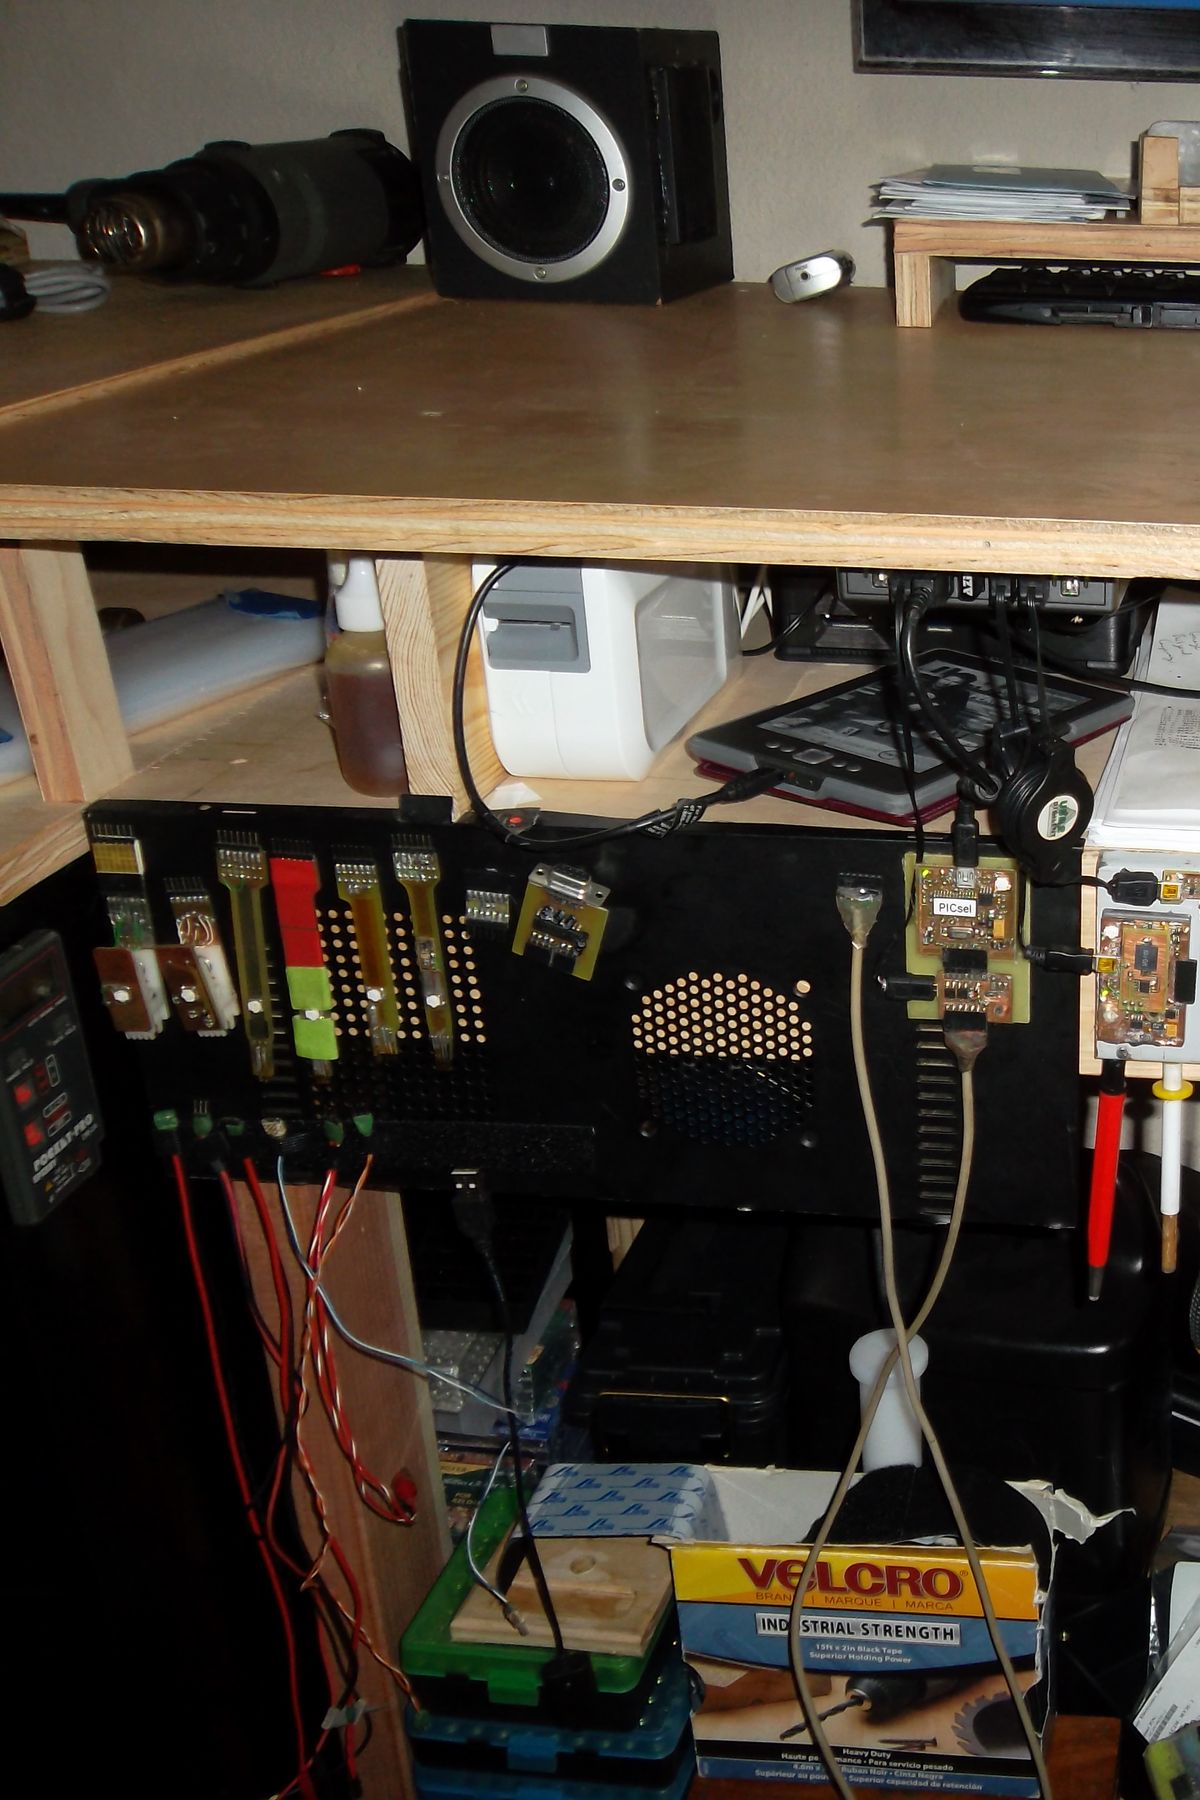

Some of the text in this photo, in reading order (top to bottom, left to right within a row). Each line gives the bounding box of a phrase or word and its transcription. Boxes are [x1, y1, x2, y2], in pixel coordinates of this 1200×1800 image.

[938, 903, 972, 913] PICsel
[755, 1591, 953, 1610] BRAN MARQUE MARCA
[762, 1618, 954, 1641] INDSTRIAL STRENGTH
[857, 1645, 881, 1653] Black
[882, 1647, 903, 1655] Tape
[809, 1651, 912, 1664] Superior Holding Power
[843, 1748, 891, 1759] Heavy Duty
[868, 1759, 887, 1767] Para
[889, 1761, 921, 1769] servicio
[922, 1763, 954, 1771] pesado
[848, 1775, 886, 1785] Superior
[886, 1778, 929, 1787] capacidad
[942, 1782, 983, 1791] retención
